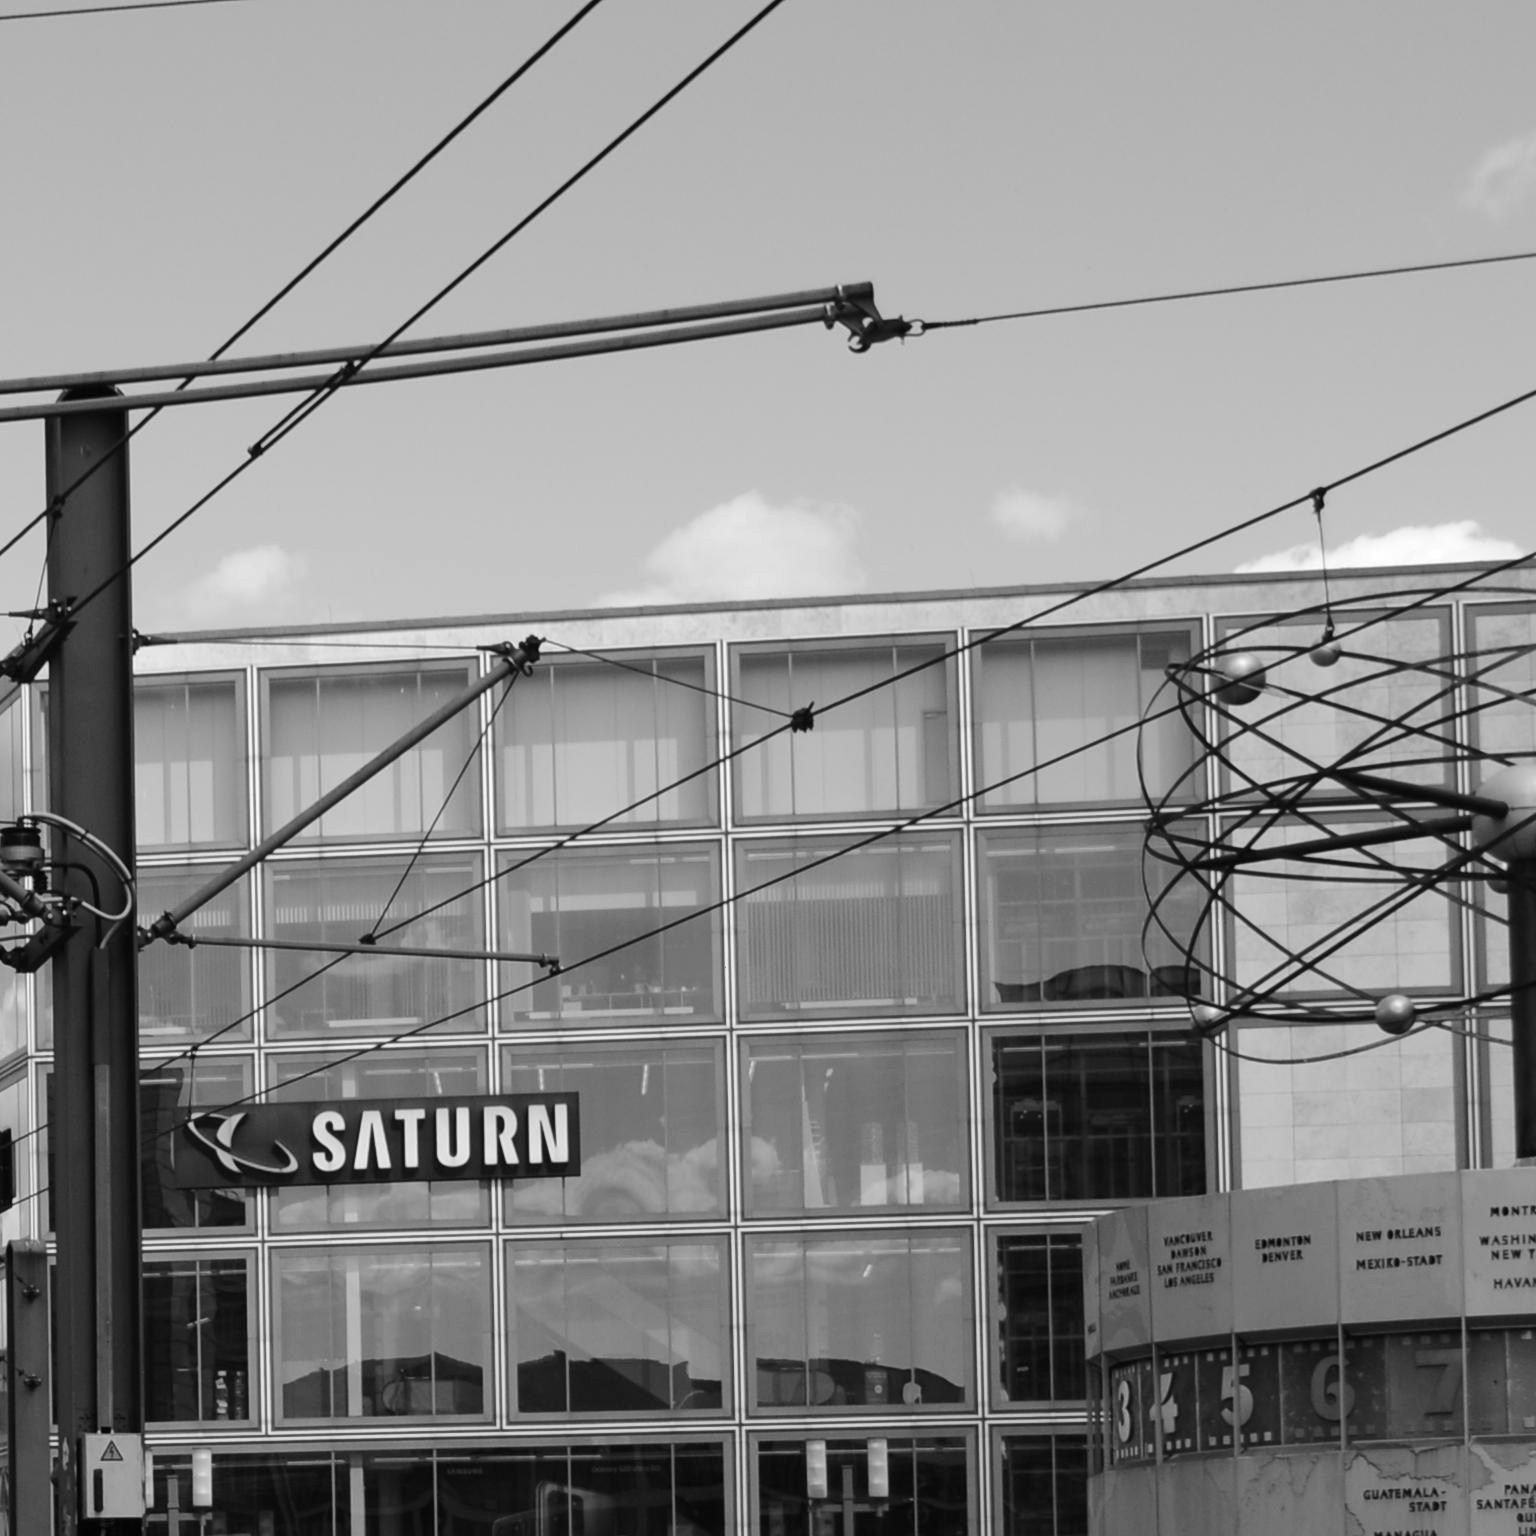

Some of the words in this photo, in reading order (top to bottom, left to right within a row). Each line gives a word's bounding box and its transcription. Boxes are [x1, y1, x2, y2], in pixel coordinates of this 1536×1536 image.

[312, 1103, 569, 1172] SATURN
[1163, 1230, 1213, 1247] VANCOUVER
[1254, 1234, 1311, 1250] EDMONTON
[1356, 1230, 1382, 1243] NEW
[1387, 1226, 1442, 1240] ORLEANS
[1171, 1245, 1207, 1260] DAWSON
[1261, 1249, 1304, 1263] DENVER
[1491, 1249, 1522, 1260] NEW
[1157, 1263, 1173, 1276] SAN
[1175, 1257, 1222, 1273] FRANCISCO
[1356, 1254, 1443, 1271] MEXIKO-STADT
[1164, 1276, 1178, 1288] LOS
[1179, 1272, 1215, 1286] ANGELES
[1310, 1355, 1356, 1422] 6
[1415, 1347, 1469, 1415] 7
[1148, 1372, 1178, 1434] 4
[1221, 1363, 1254, 1427] 5
[1117, 1379, 1131, 1443] 3
[1363, 1487, 1447, 1501] GUATEMALA-
[1408, 1501, 1447, 1513] STADT
